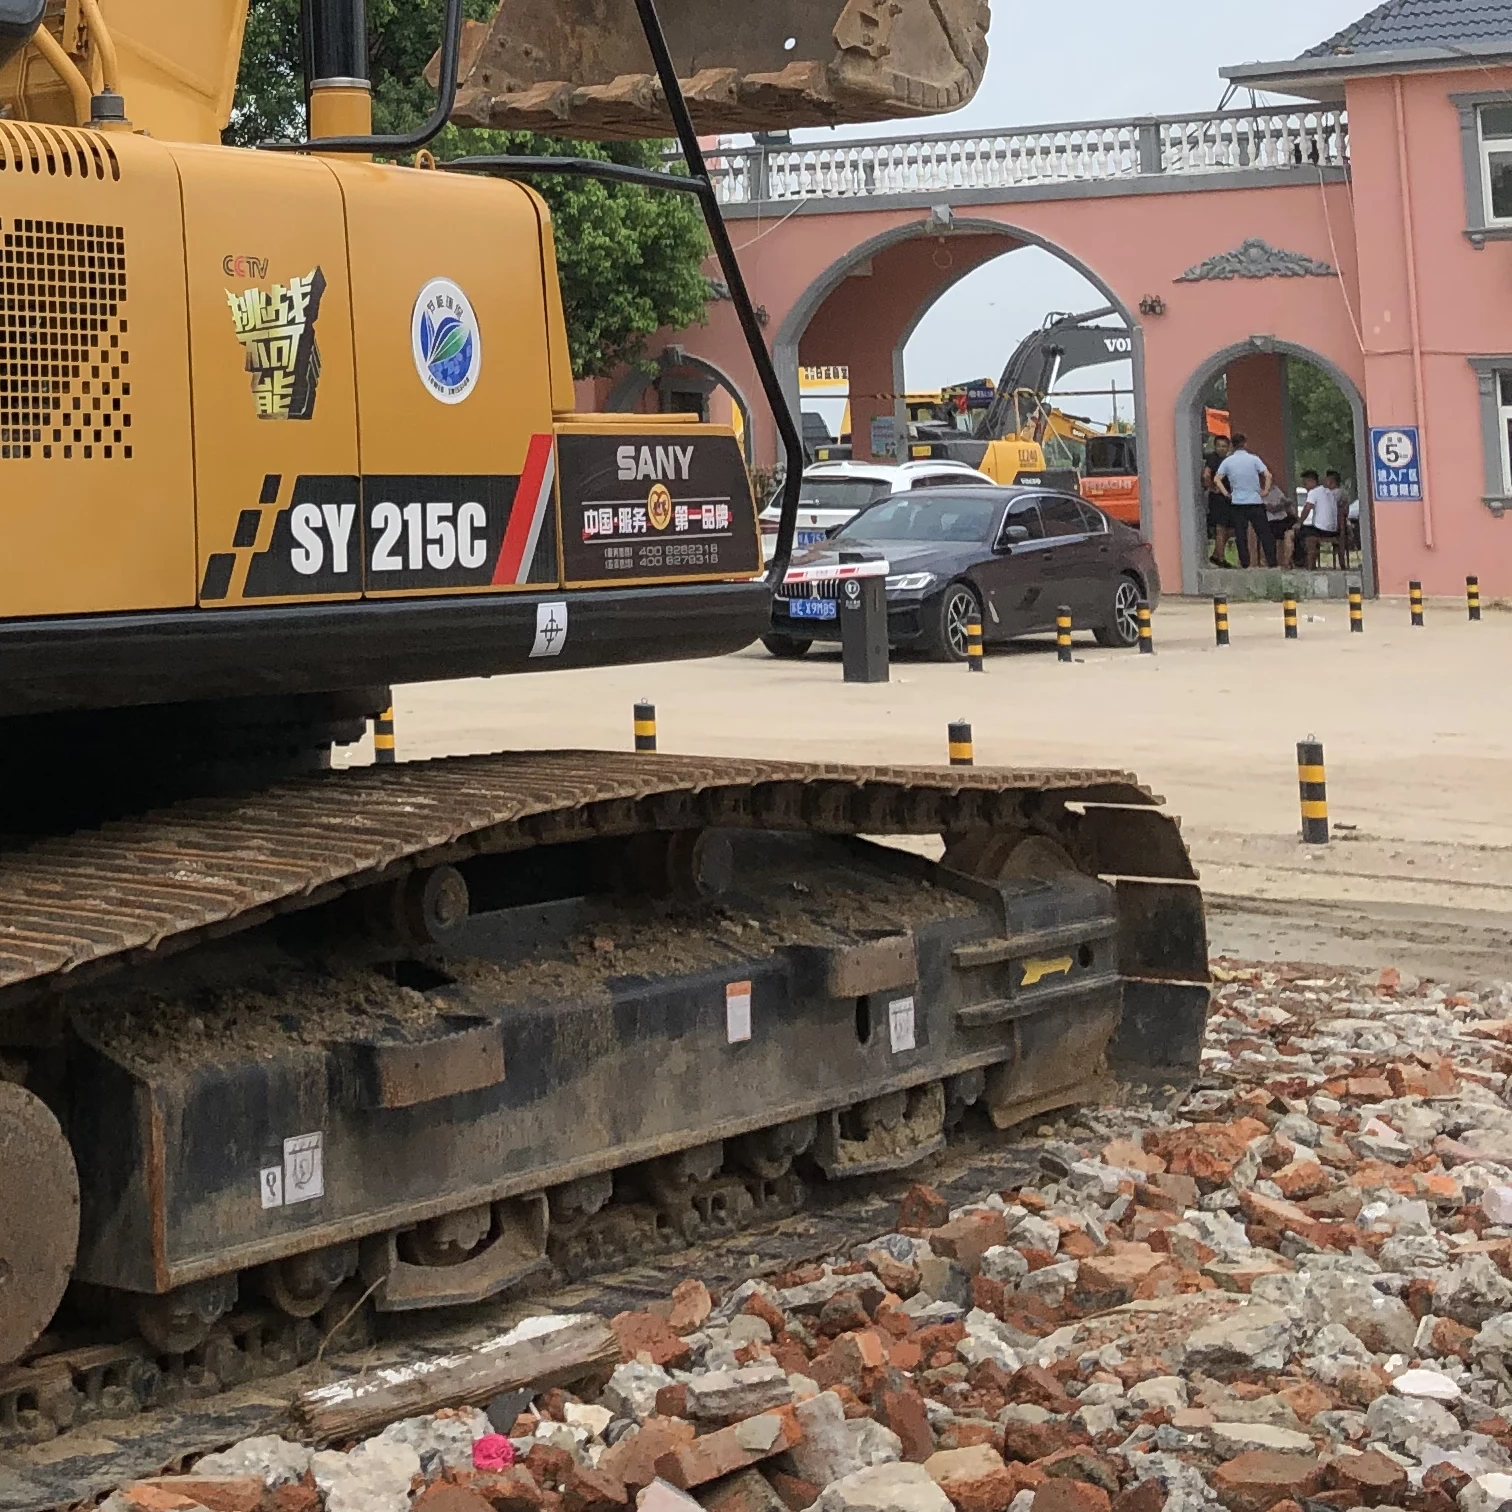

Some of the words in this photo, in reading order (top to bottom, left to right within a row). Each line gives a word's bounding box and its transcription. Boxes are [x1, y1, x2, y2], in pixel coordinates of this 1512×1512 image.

[223, 254, 270, 279] CCTV
[617, 445, 695, 481] SANY
[1386, 444, 1399, 463] 5
[290, 503, 356, 575] SY
[370, 501, 487, 572] 215C
[639, 545, 662, 557] 400
[639, 556, 663, 568] 400
